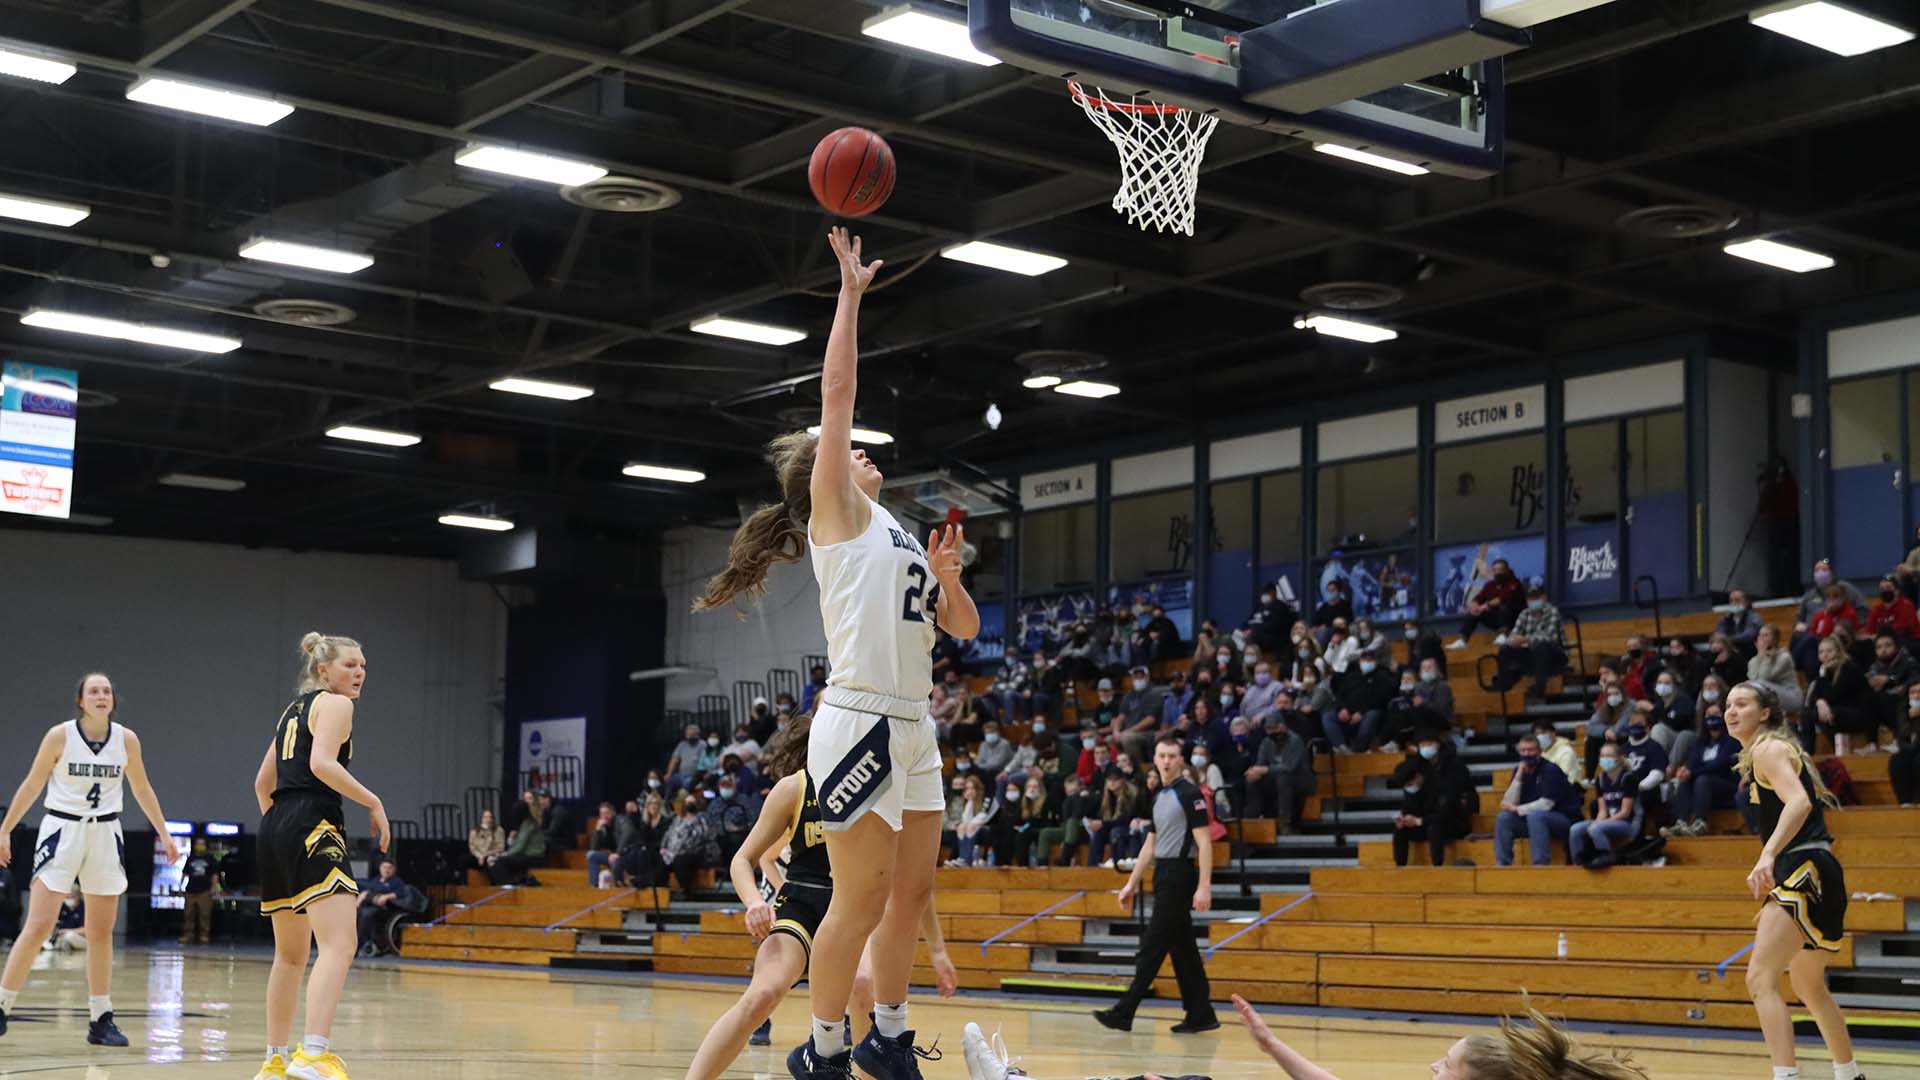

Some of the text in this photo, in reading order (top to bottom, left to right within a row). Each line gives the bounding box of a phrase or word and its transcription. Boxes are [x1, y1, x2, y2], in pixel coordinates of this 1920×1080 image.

[1456, 401, 1524, 429] SECTION B
[1033, 476, 1084, 499] SECTION A
[1568, 545, 1601, 571] Blue
[1571, 553, 1617, 583] Devils
[68, 762, 121, 779] BLUE DEVILS
[826, 749, 882, 815] STOUT
[86, 783, 101, 809] 4
